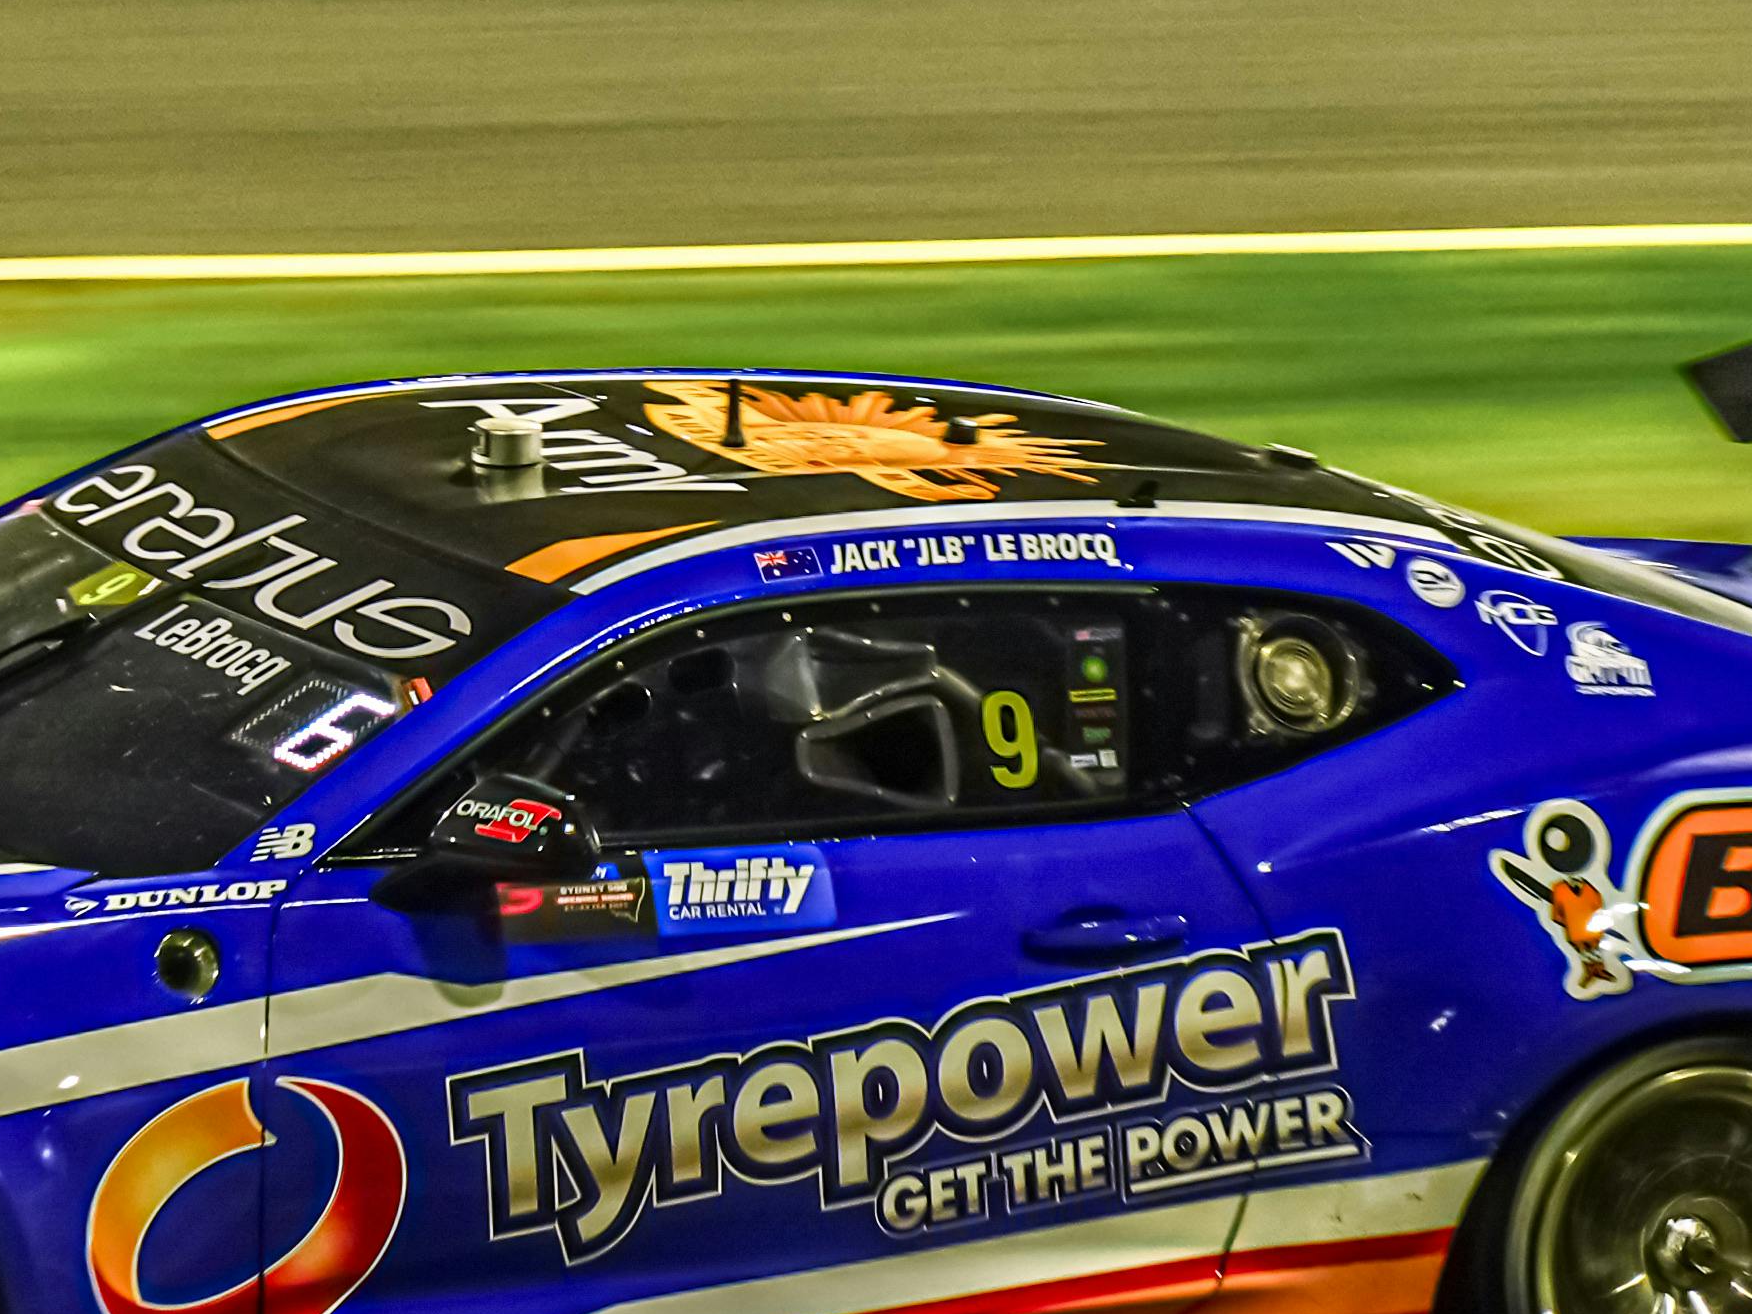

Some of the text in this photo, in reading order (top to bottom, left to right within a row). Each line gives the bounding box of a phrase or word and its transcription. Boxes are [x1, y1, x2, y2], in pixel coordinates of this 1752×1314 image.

[53, 463, 473, 659] erebus
[831, 539, 901, 575] JACK
[982, 533, 1019, 562] LE
[1018, 532, 1122, 568] BROCQ
[134, 603, 292, 696] LeBrocq
[274, 691, 396, 772] 6
[982, 690, 1038, 789] 9
[456, 799, 538, 831] ORAFOL
[103, 879, 287, 911] DUNLOP
[663, 857, 815, 914] Thrifty
[669, 901, 766, 920] CAR RENTAL
[468, 947, 1333, 1242] Tyrepower
[882, 1090, 1349, 1231] GET THE POWER
